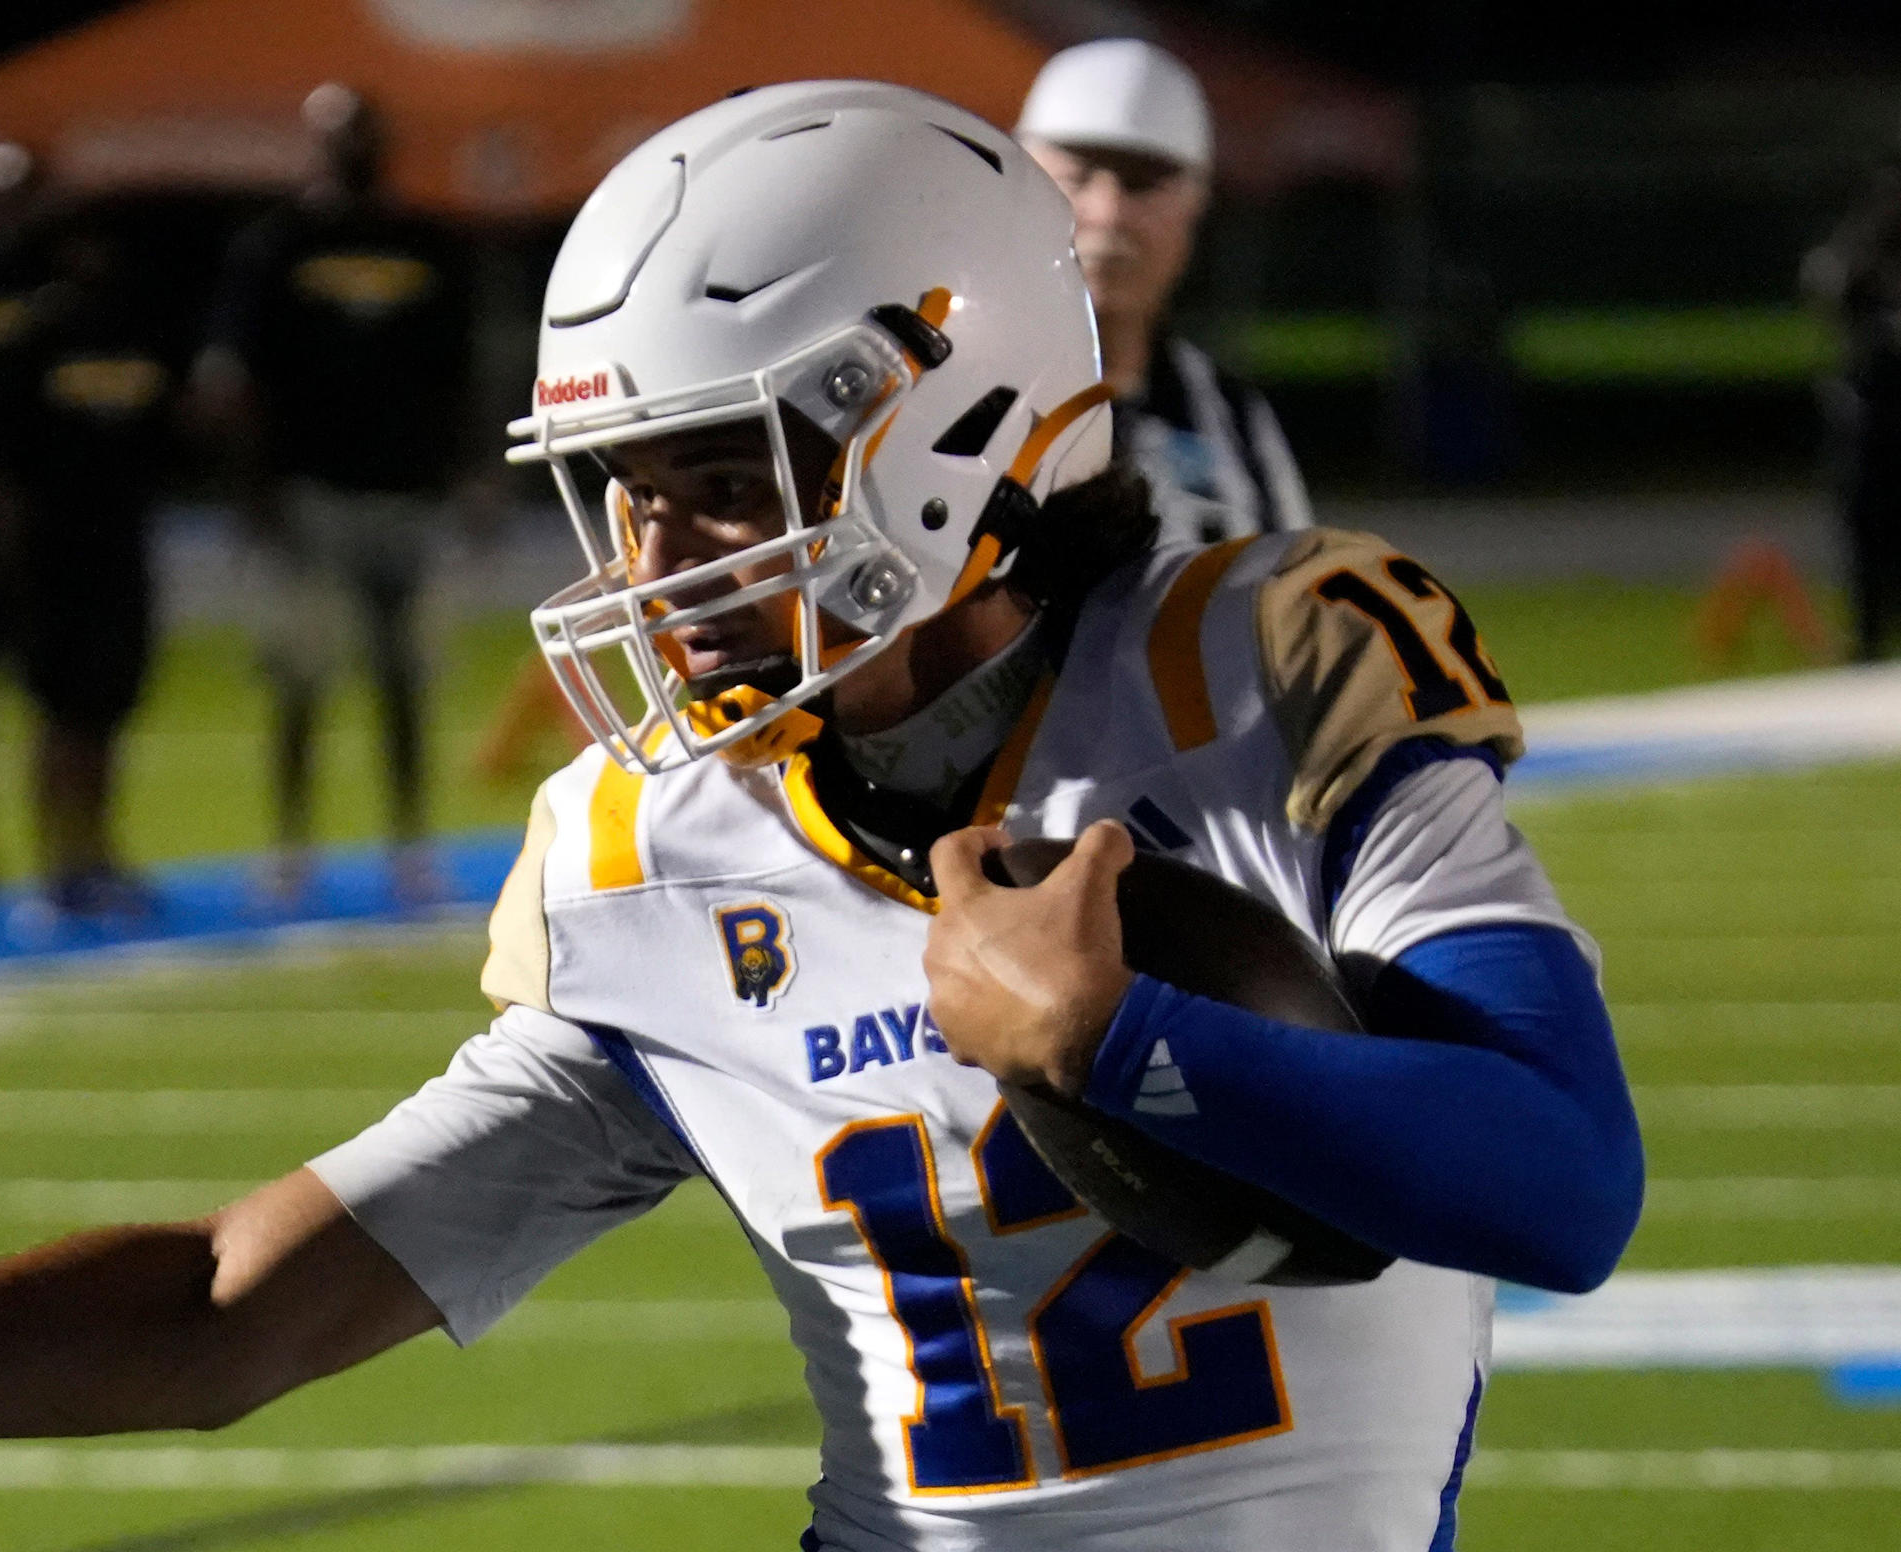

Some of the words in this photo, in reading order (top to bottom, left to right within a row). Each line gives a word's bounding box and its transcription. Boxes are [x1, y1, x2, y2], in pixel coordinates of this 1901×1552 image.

[537, 371, 608, 406] Riddell
[1310, 554, 1513, 722] 12
[813, 1096, 1294, 1497] 12
